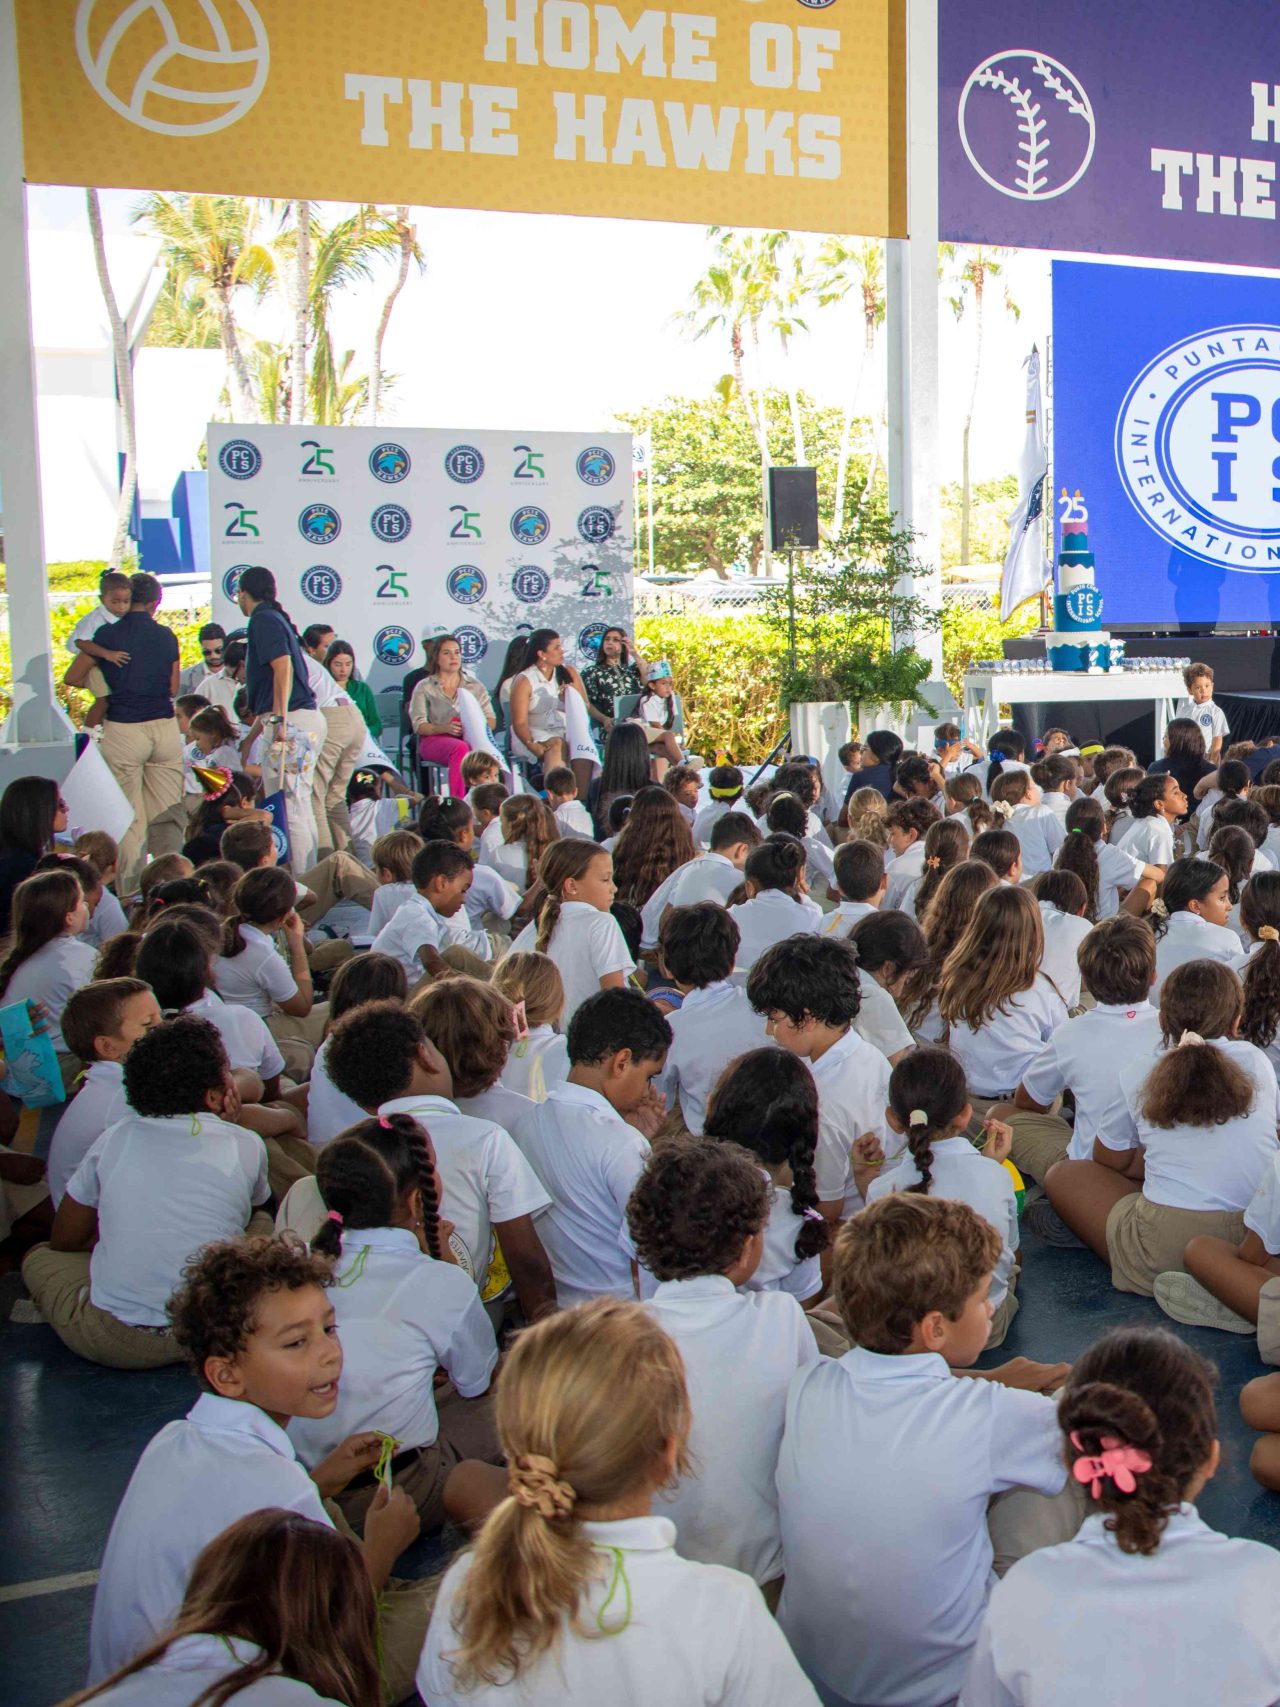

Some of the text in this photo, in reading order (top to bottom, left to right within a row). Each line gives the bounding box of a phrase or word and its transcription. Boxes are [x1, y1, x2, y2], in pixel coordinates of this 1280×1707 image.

[484, 0, 841, 93] HOME OF
[344, 73, 842, 181] THE HAWKS
[1150, 147, 1277, 221] THE
[231, 450, 250, 460] PC
[300, 440, 336, 475] 25
[456, 455, 474, 465] PC
[513, 445, 546, 478] 25
[223, 502, 260, 537] 25
[382, 514, 400, 523] PC
[449, 504, 482, 538] 25
[1058, 496, 1089, 524] 25
[312, 575, 330, 585] PC
[375, 564, 409, 598] 25
[581, 564, 612, 597] 25
[1077, 592, 1094, 604] PC
